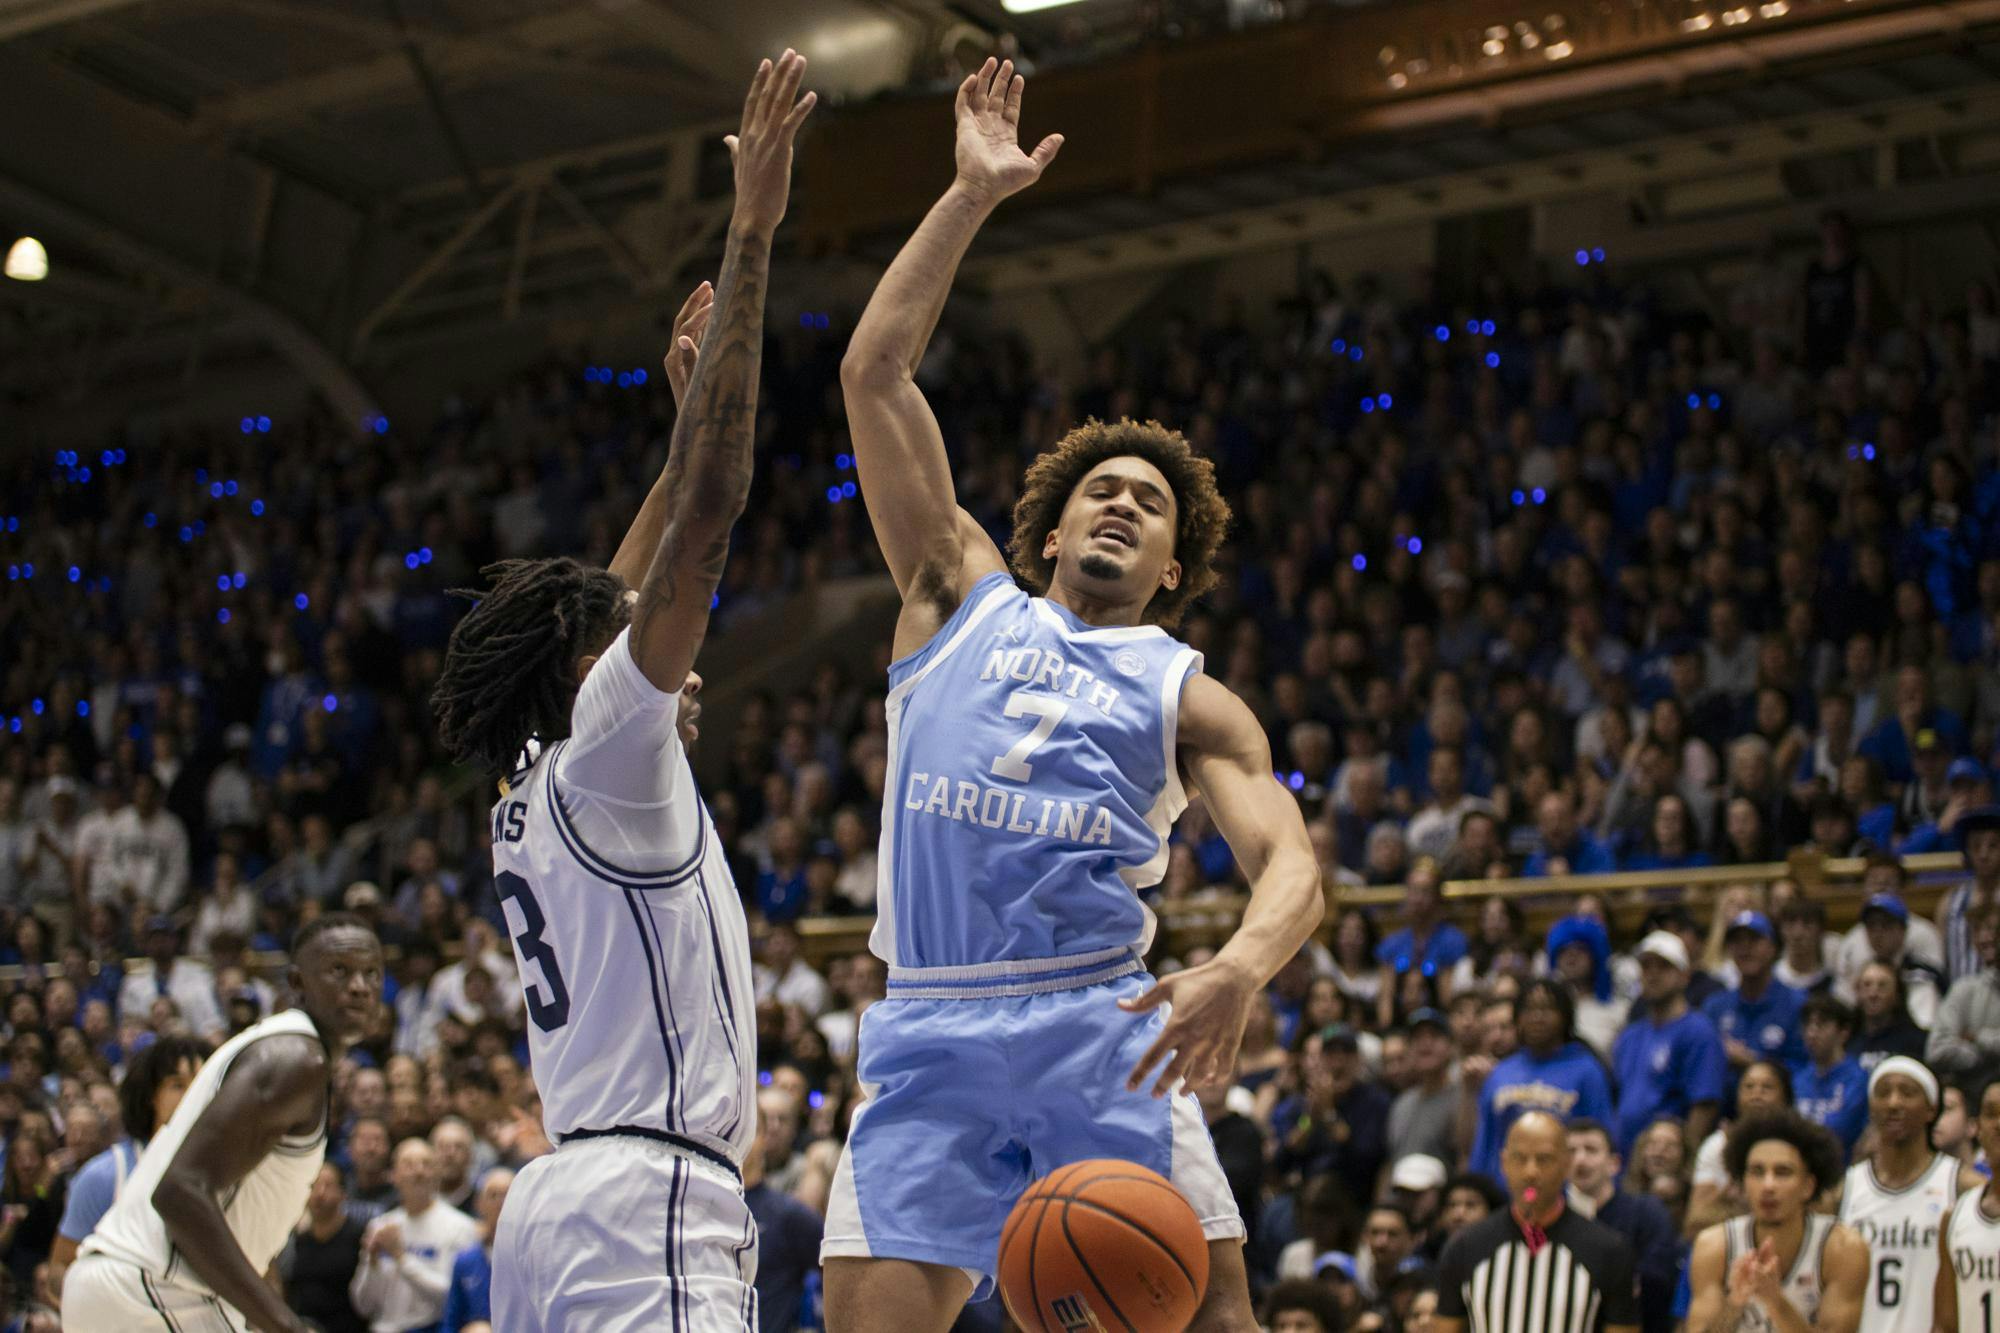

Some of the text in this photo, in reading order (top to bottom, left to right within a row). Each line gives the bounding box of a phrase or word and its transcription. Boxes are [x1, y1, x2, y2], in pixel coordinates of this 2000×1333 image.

[979, 648, 1120, 716] NORTH
[990, 691, 1069, 783] 7
[904, 773, 1112, 845] CAROLINA
[495, 870, 570, 1032] 3
[1878, 1257, 1902, 1307] 6
[1954, 1246, 2000, 1281] Du
